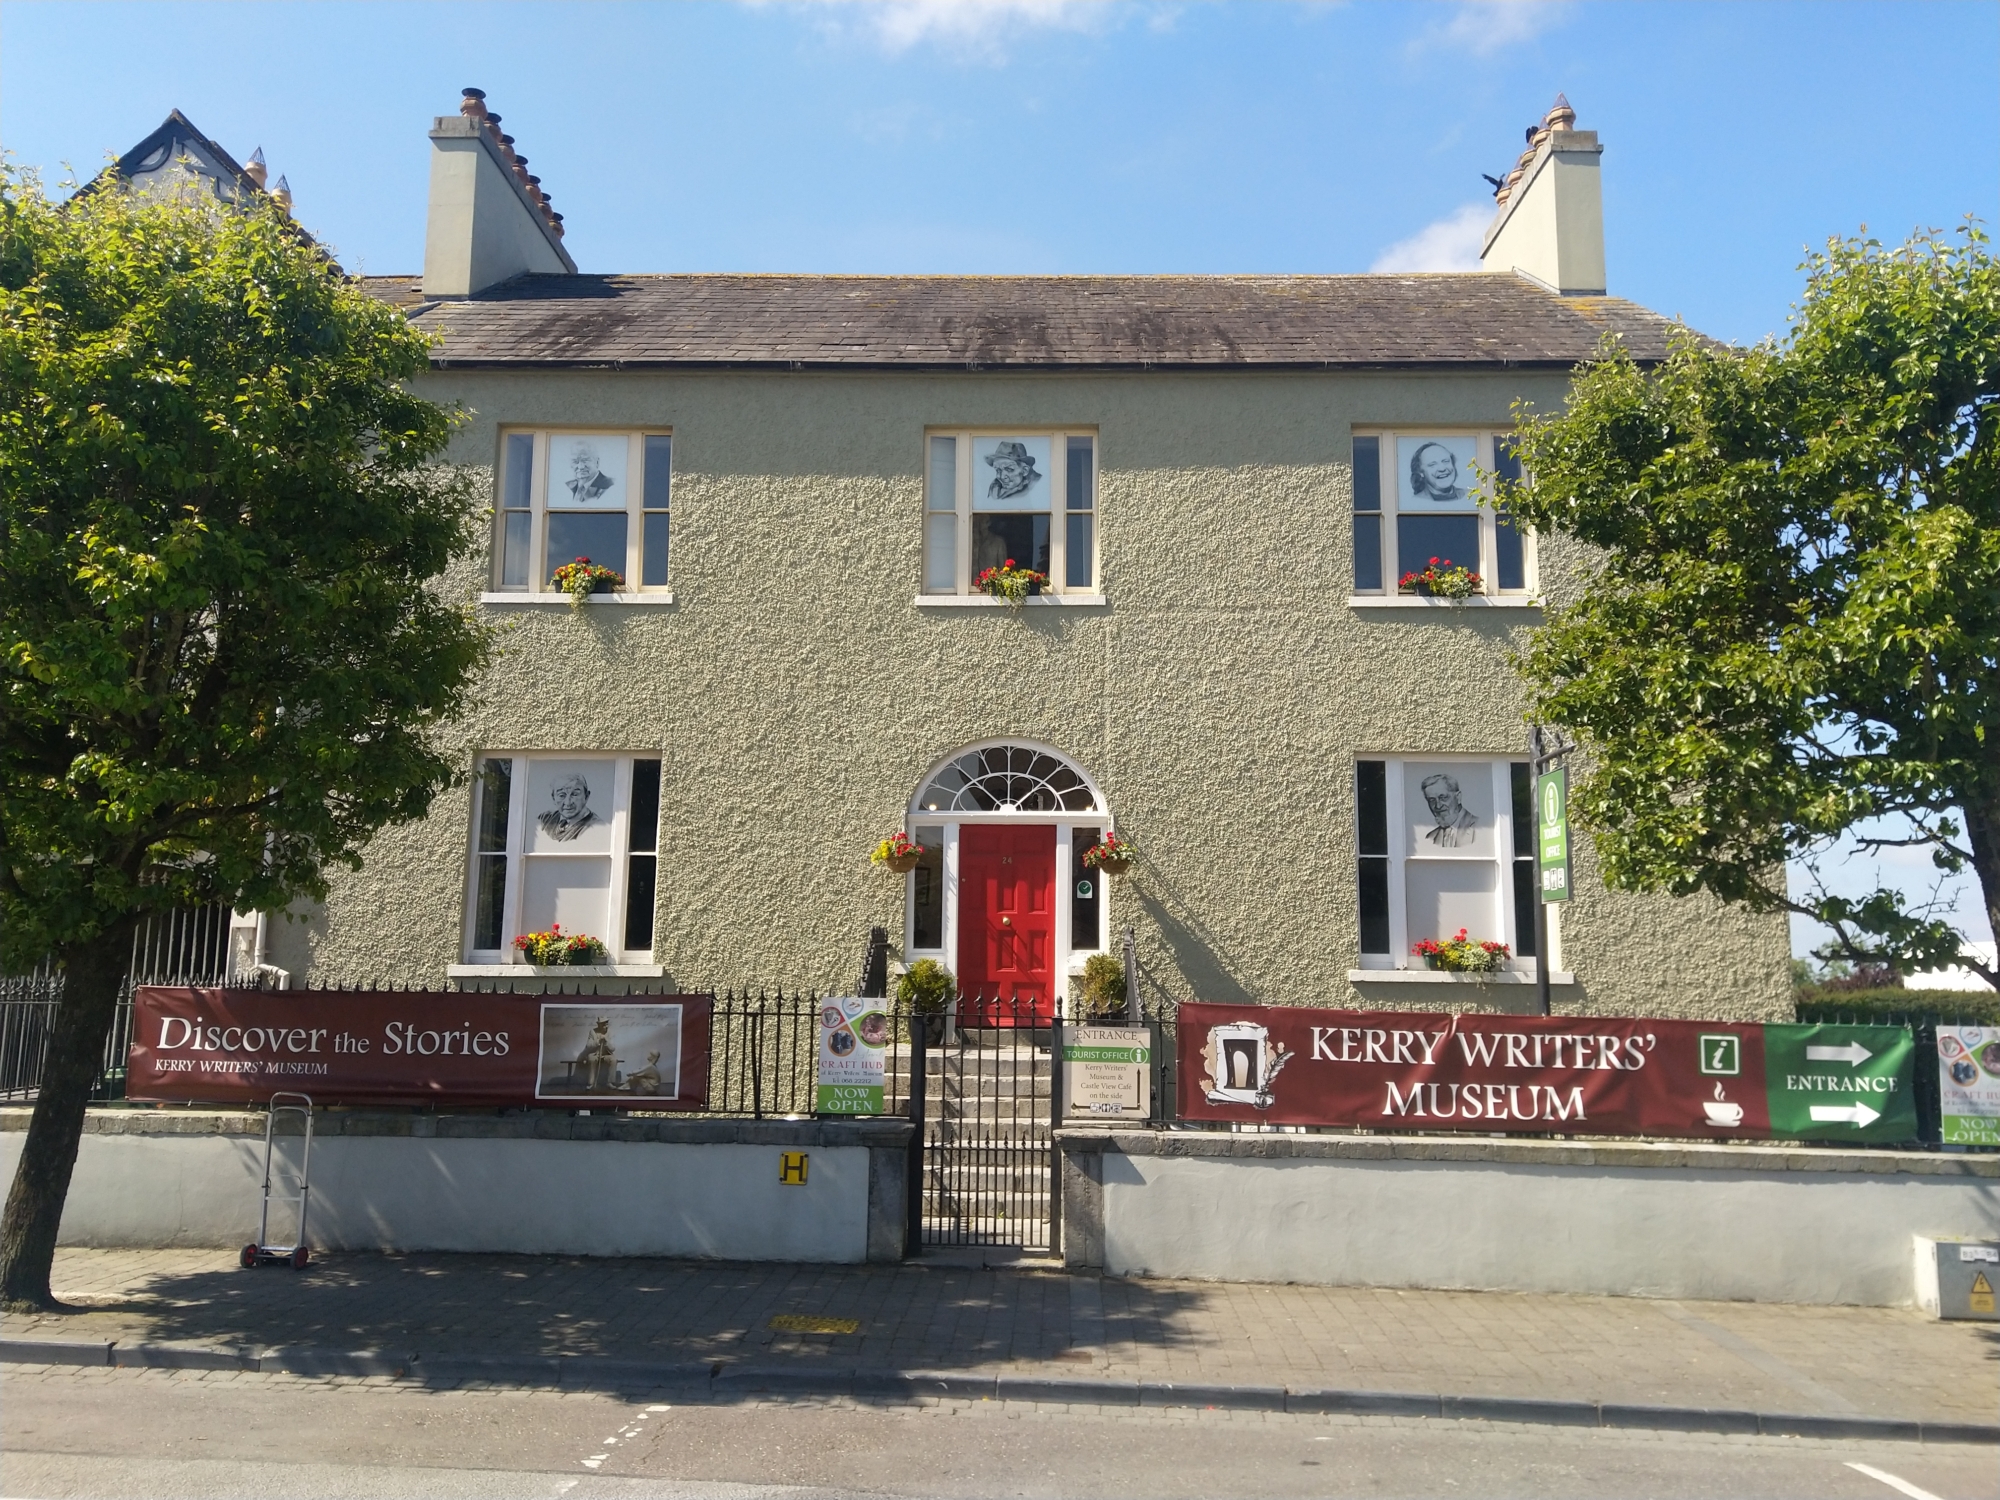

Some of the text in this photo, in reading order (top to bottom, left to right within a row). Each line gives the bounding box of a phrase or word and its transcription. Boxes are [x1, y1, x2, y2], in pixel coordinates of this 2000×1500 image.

[1543, 825, 1562, 840] TOURIST
[1545, 844, 1561, 858] OFFICE
[1002, 856, 1013, 864] 24
[156, 1016, 510, 1056] Discover the Stories
[1076, 1030, 1138, 1041] ENTRANCE
[1067, 1050, 1129, 1060] TOURIST OFFICE
[1310, 1027, 1656, 1071] KERRY WRITERS'
[154, 1059, 328, 1075] KERRY WRITERS' MUSEUM
[821, 1060, 883, 1069] CRAFT HUB
[1085, 1064, 1102, 1072] Kerry
[1786, 1074, 1898, 1093] ENTRANCE
[833, 1088, 869, 1099] NOW
[827, 1100, 873, 1112] OPEN
[1382, 1081, 1588, 1121] MUSEUM
[1959, 1117, 1997, 1130] NOW
[784, 1154, 804, 1181] H
